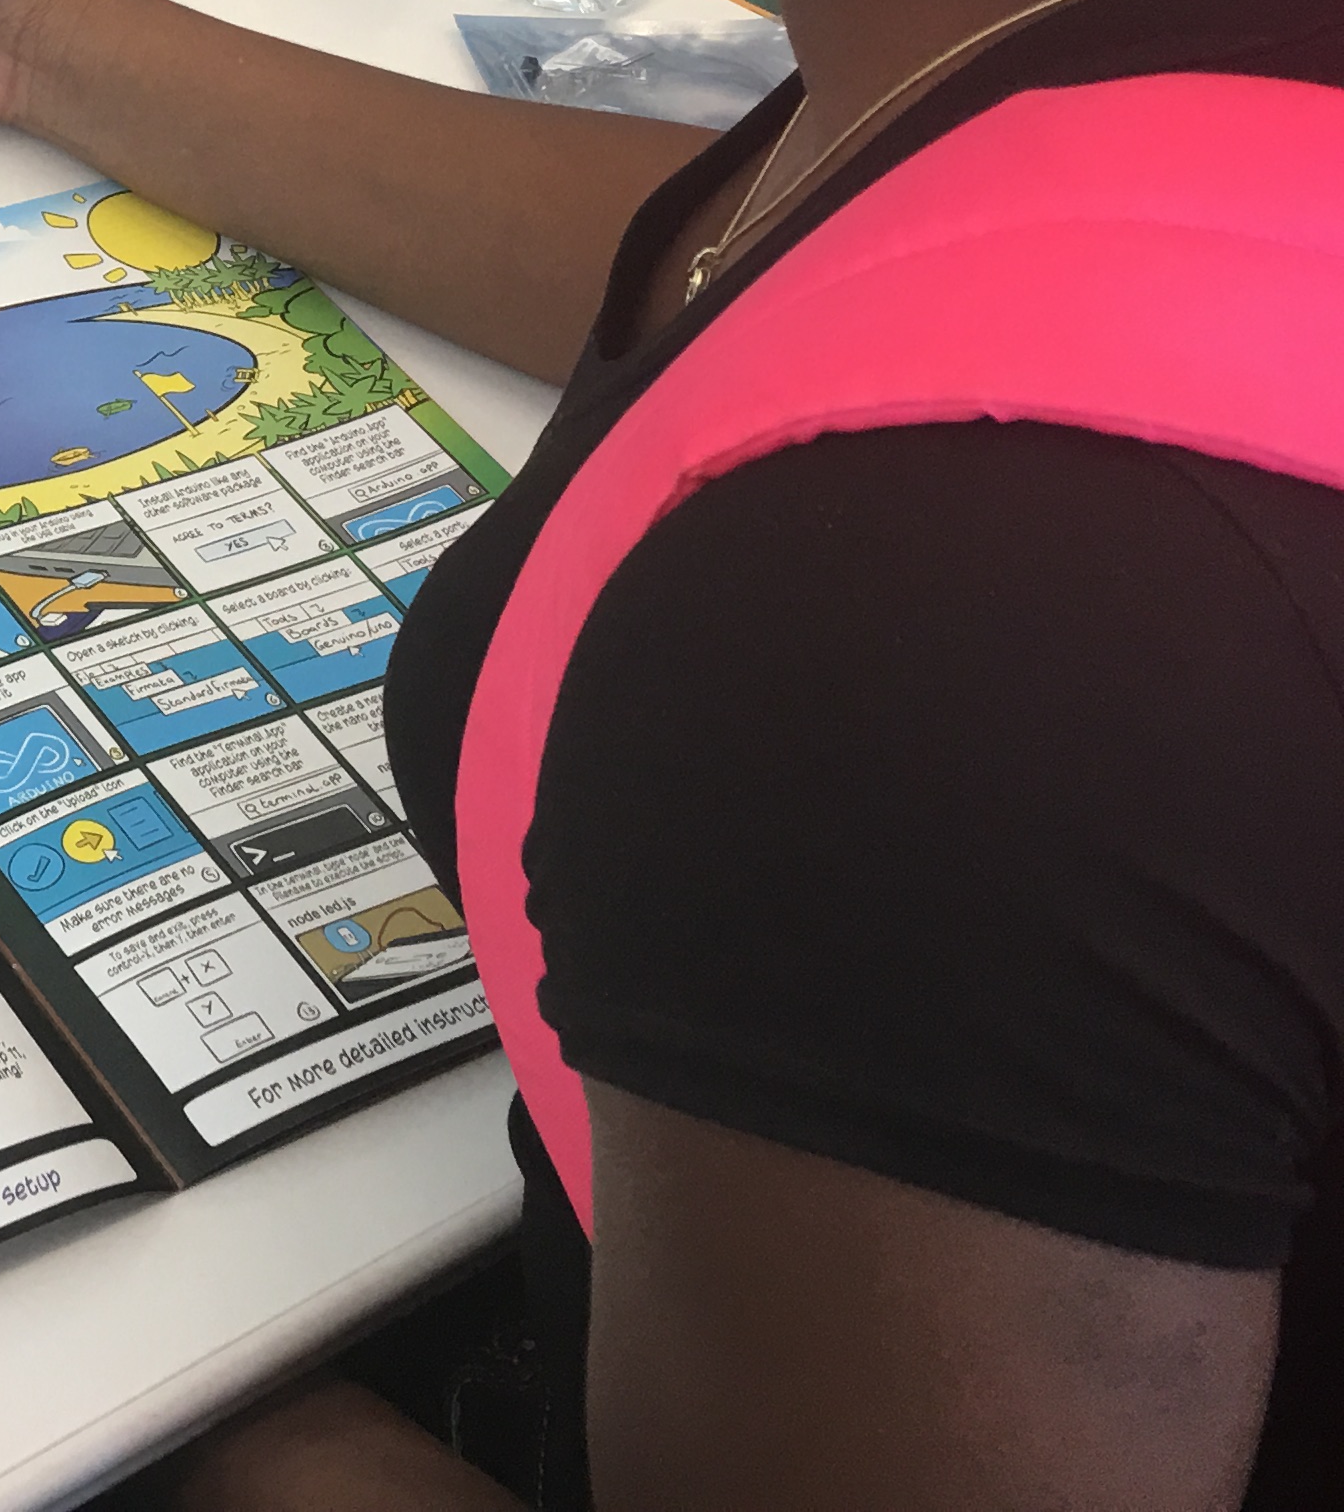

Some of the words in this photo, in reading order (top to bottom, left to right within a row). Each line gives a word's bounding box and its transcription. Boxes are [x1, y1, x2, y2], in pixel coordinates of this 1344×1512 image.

[4, 669, 26, 683] app
[0, 688, 13, 698] it
[287, 910, 321, 928] node
[318, 897, 356, 916] led.js
[7, 1046, 26, 1063] 11,
[247, 1082, 282, 1109] For
[286, 1058, 337, 1092] more
[339, 1020, 417, 1070] detailed
